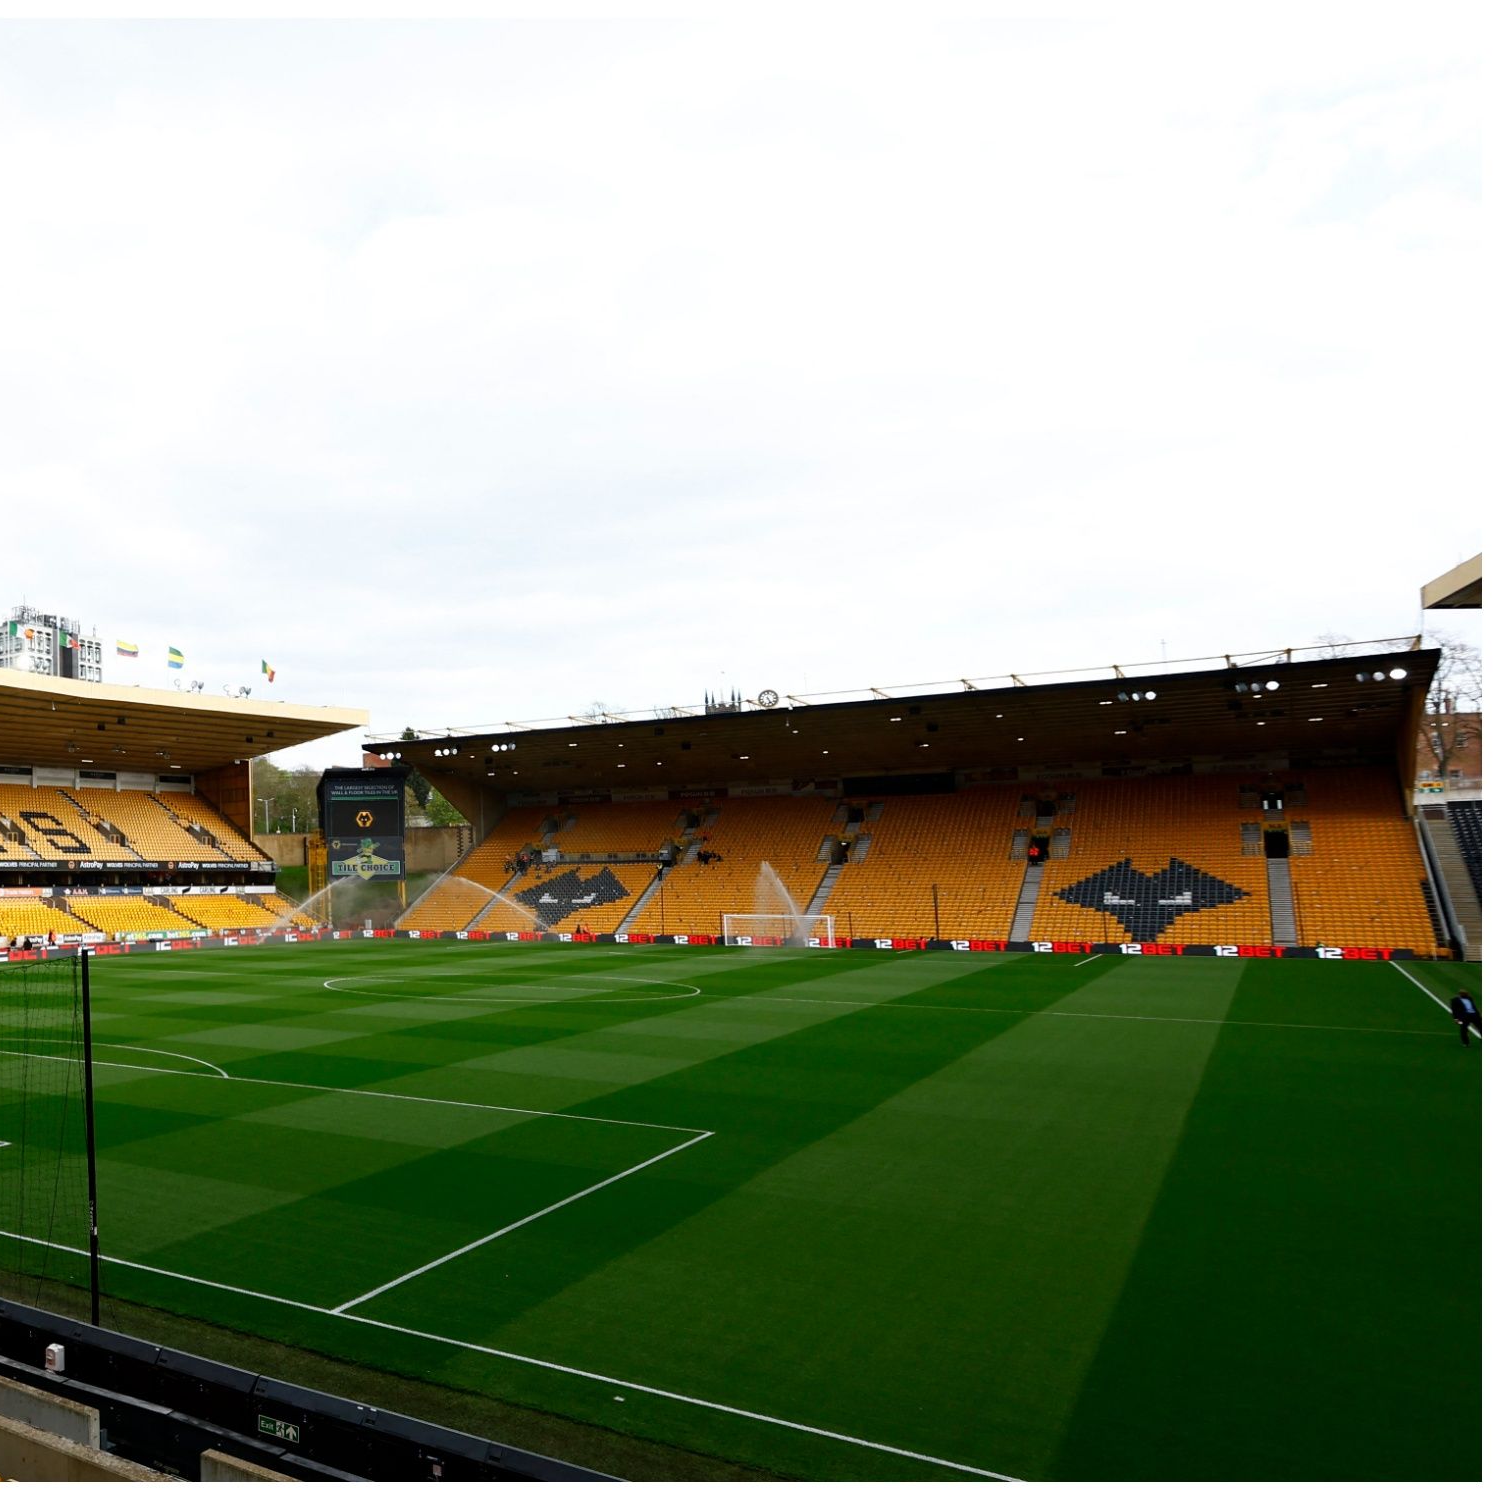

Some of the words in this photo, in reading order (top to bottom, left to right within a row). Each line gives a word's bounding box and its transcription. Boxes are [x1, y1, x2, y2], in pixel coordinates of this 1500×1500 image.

[80, 860, 104, 870] AstroPay
[178, 861, 200, 870] AstroPay
[338, 864, 358, 872] TILE
[361, 864, 395, 872] CHOICE
[363, 929, 397, 938] 12BET
[409, 929, 444, 939] 12BET
[456, 930, 493, 940] 12BET
[506, 931, 543, 941] 12BET
[559, 932, 597, 943] 12BET
[614, 933, 655, 943] 12BET
[673, 934, 717, 945] 12BET
[736, 935, 783, 947] 12BET
[873, 938, 929, 949] 12BET
[950, 939, 1008, 951] 12BET
[1032, 941, 1094, 953] 12BET
[1119, 943, 1186, 955] 12BET
[1213, 945, 1287, 957] 12BET
[1315, 946, 1394, 960] 12BET
